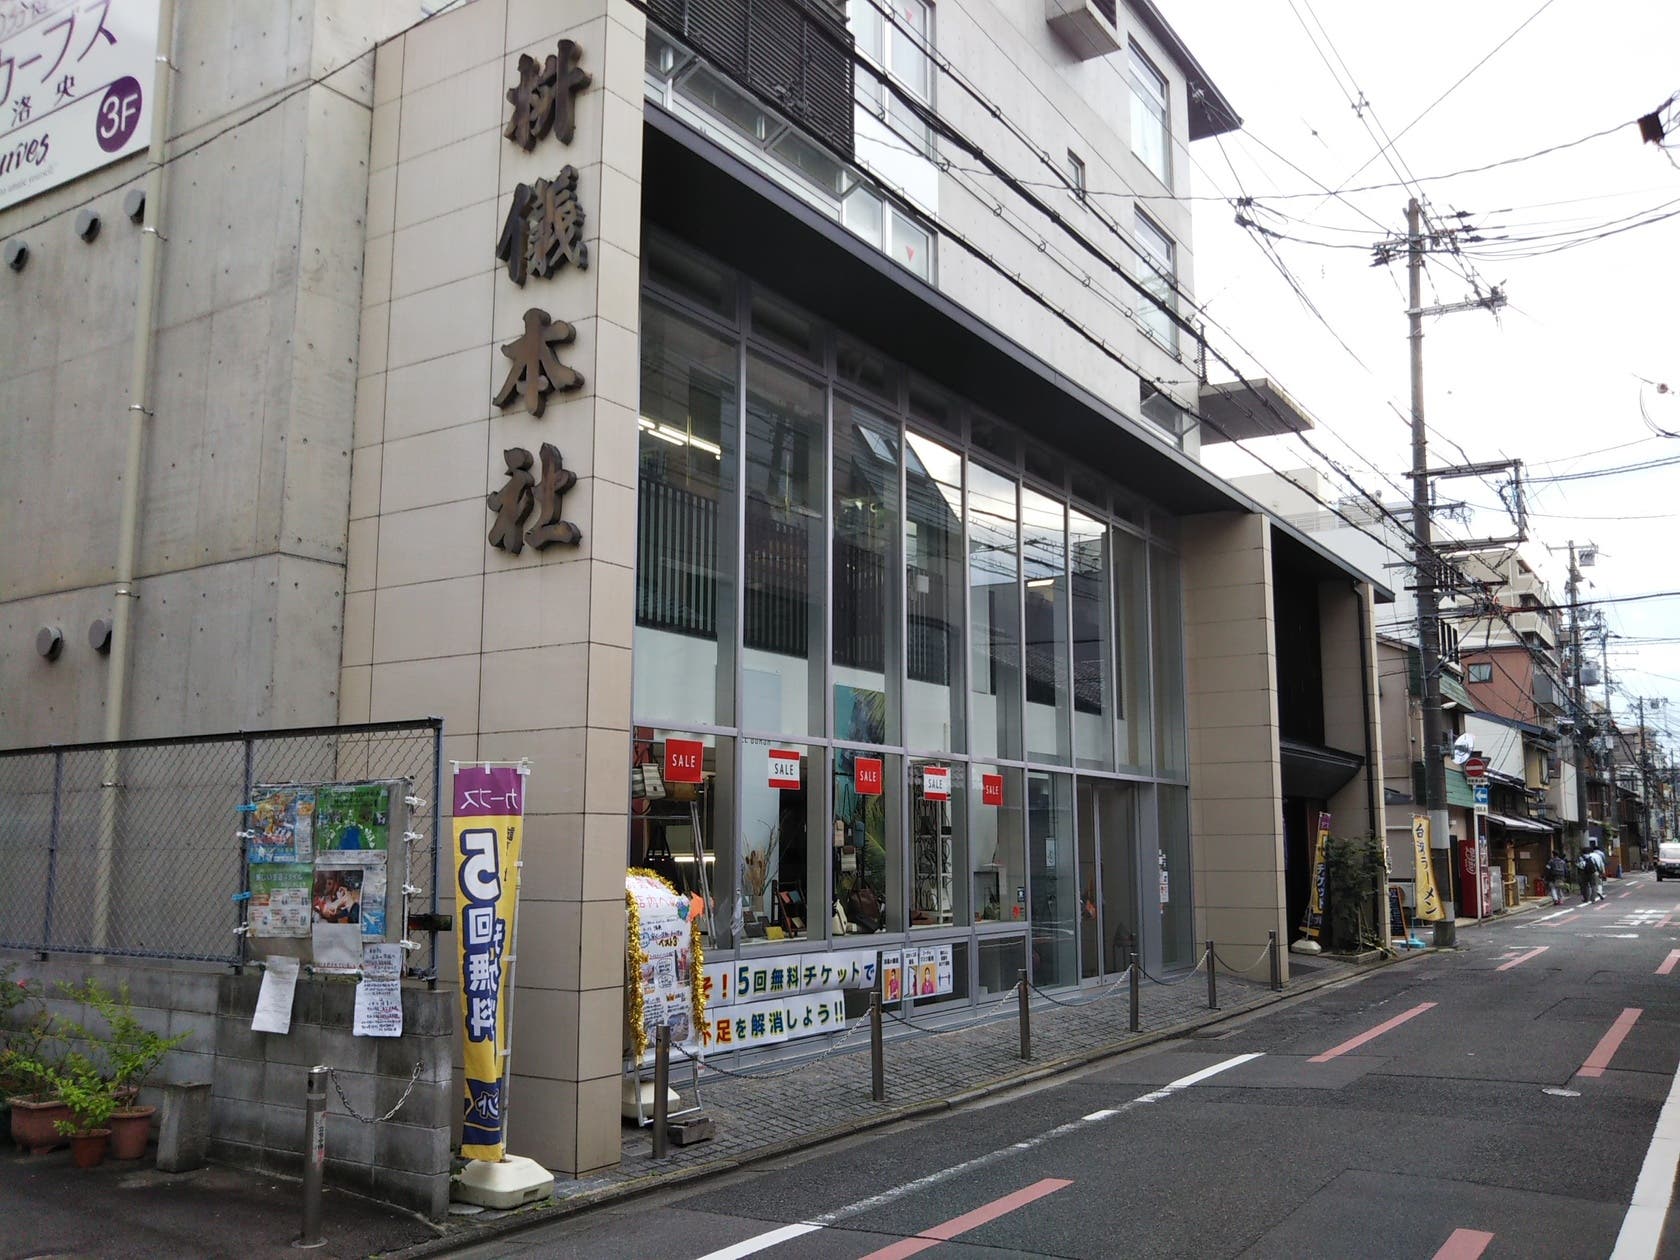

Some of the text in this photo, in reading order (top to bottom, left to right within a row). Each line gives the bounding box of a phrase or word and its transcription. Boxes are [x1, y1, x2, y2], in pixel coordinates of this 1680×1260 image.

[100, 93, 139, 139] 3F
[672, 753, 696, 769] SALE
[773, 763, 795, 777] SALE
[860, 770, 877, 783] SALE
[927, 777, 944, 791] SALE
[984, 784, 1000, 796] SALE
